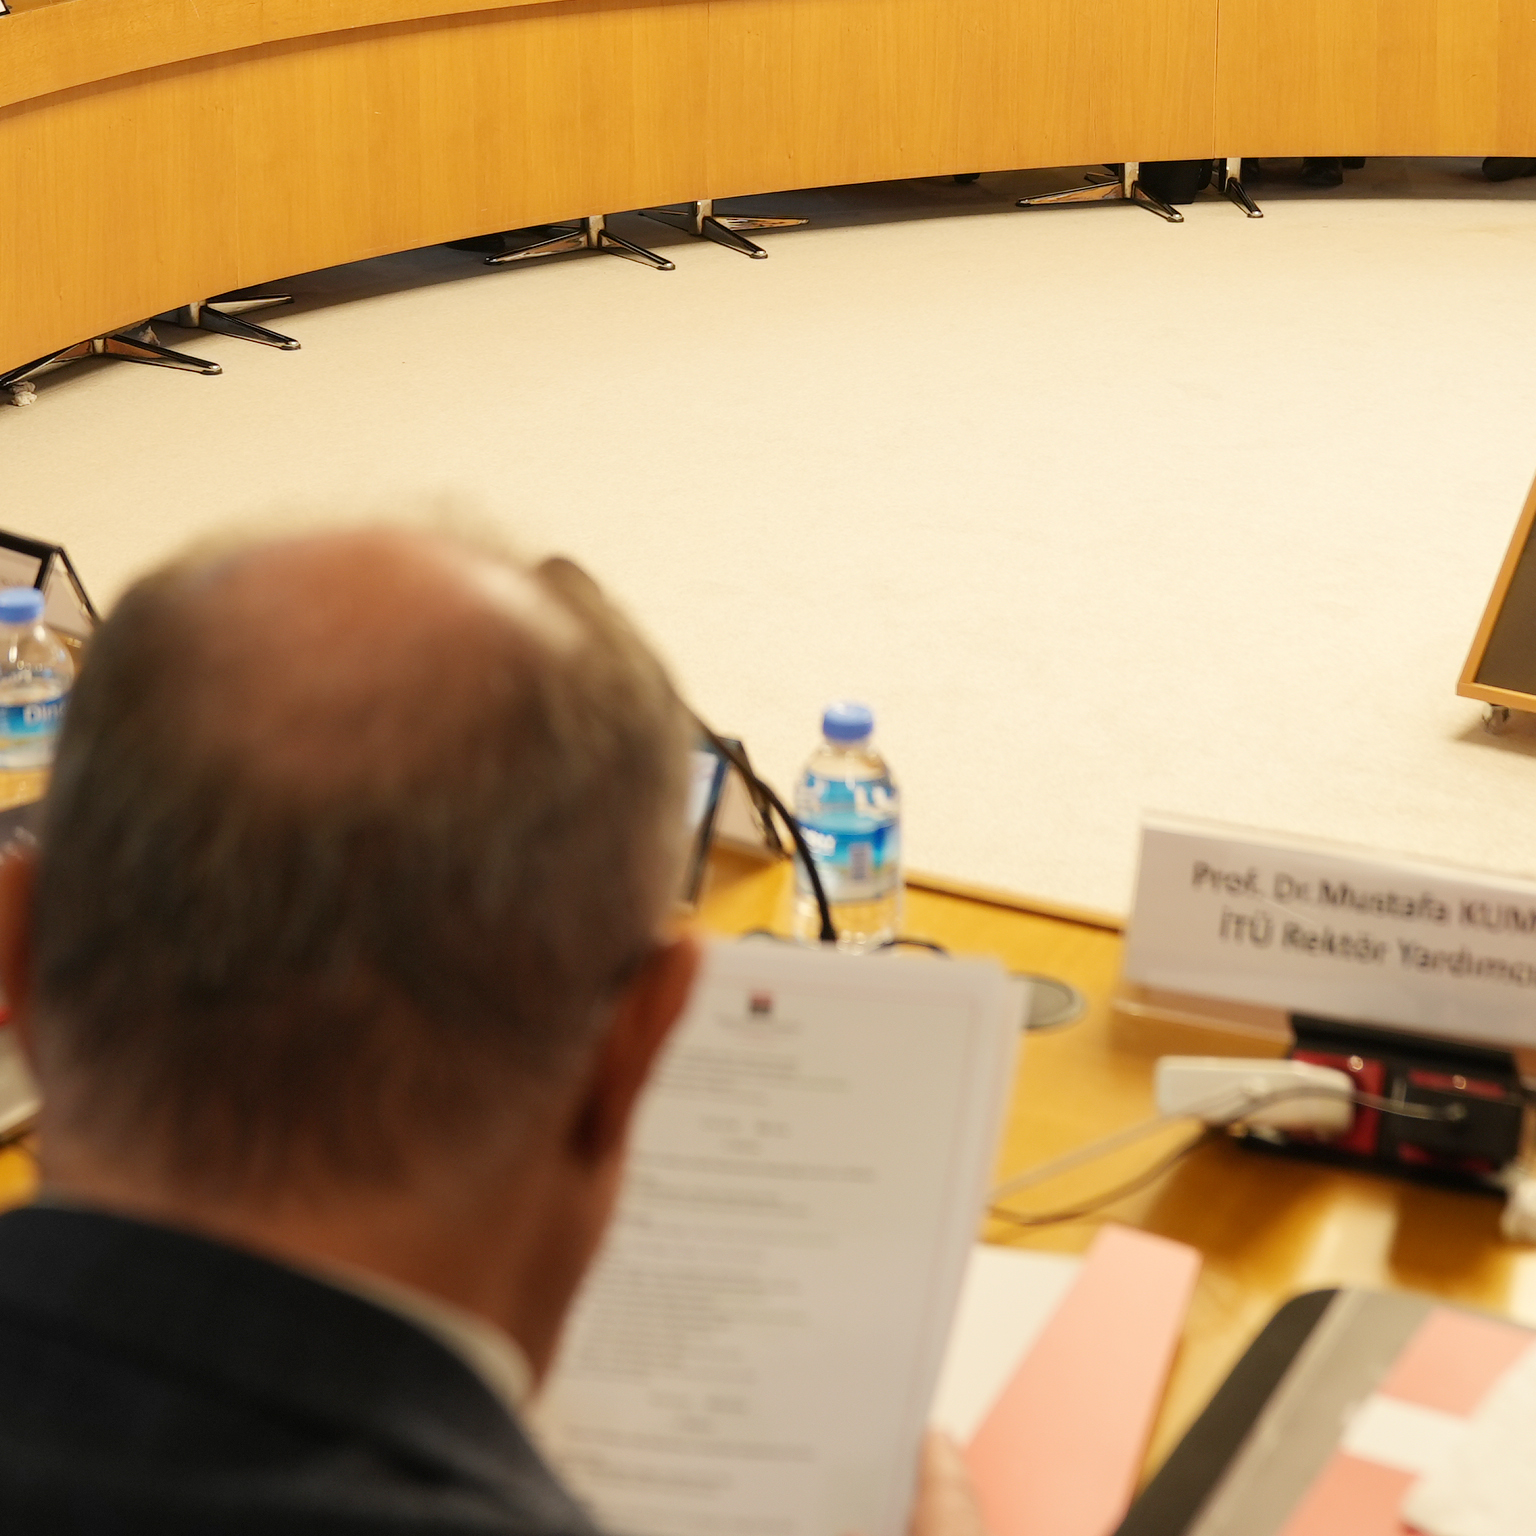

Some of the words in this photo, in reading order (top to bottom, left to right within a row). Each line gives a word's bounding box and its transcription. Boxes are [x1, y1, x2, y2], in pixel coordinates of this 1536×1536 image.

[1191, 860, 1262, 898] Prof.
[1219, 905, 1275, 946] İTÜ
[1282, 921, 1389, 969] Rektör
